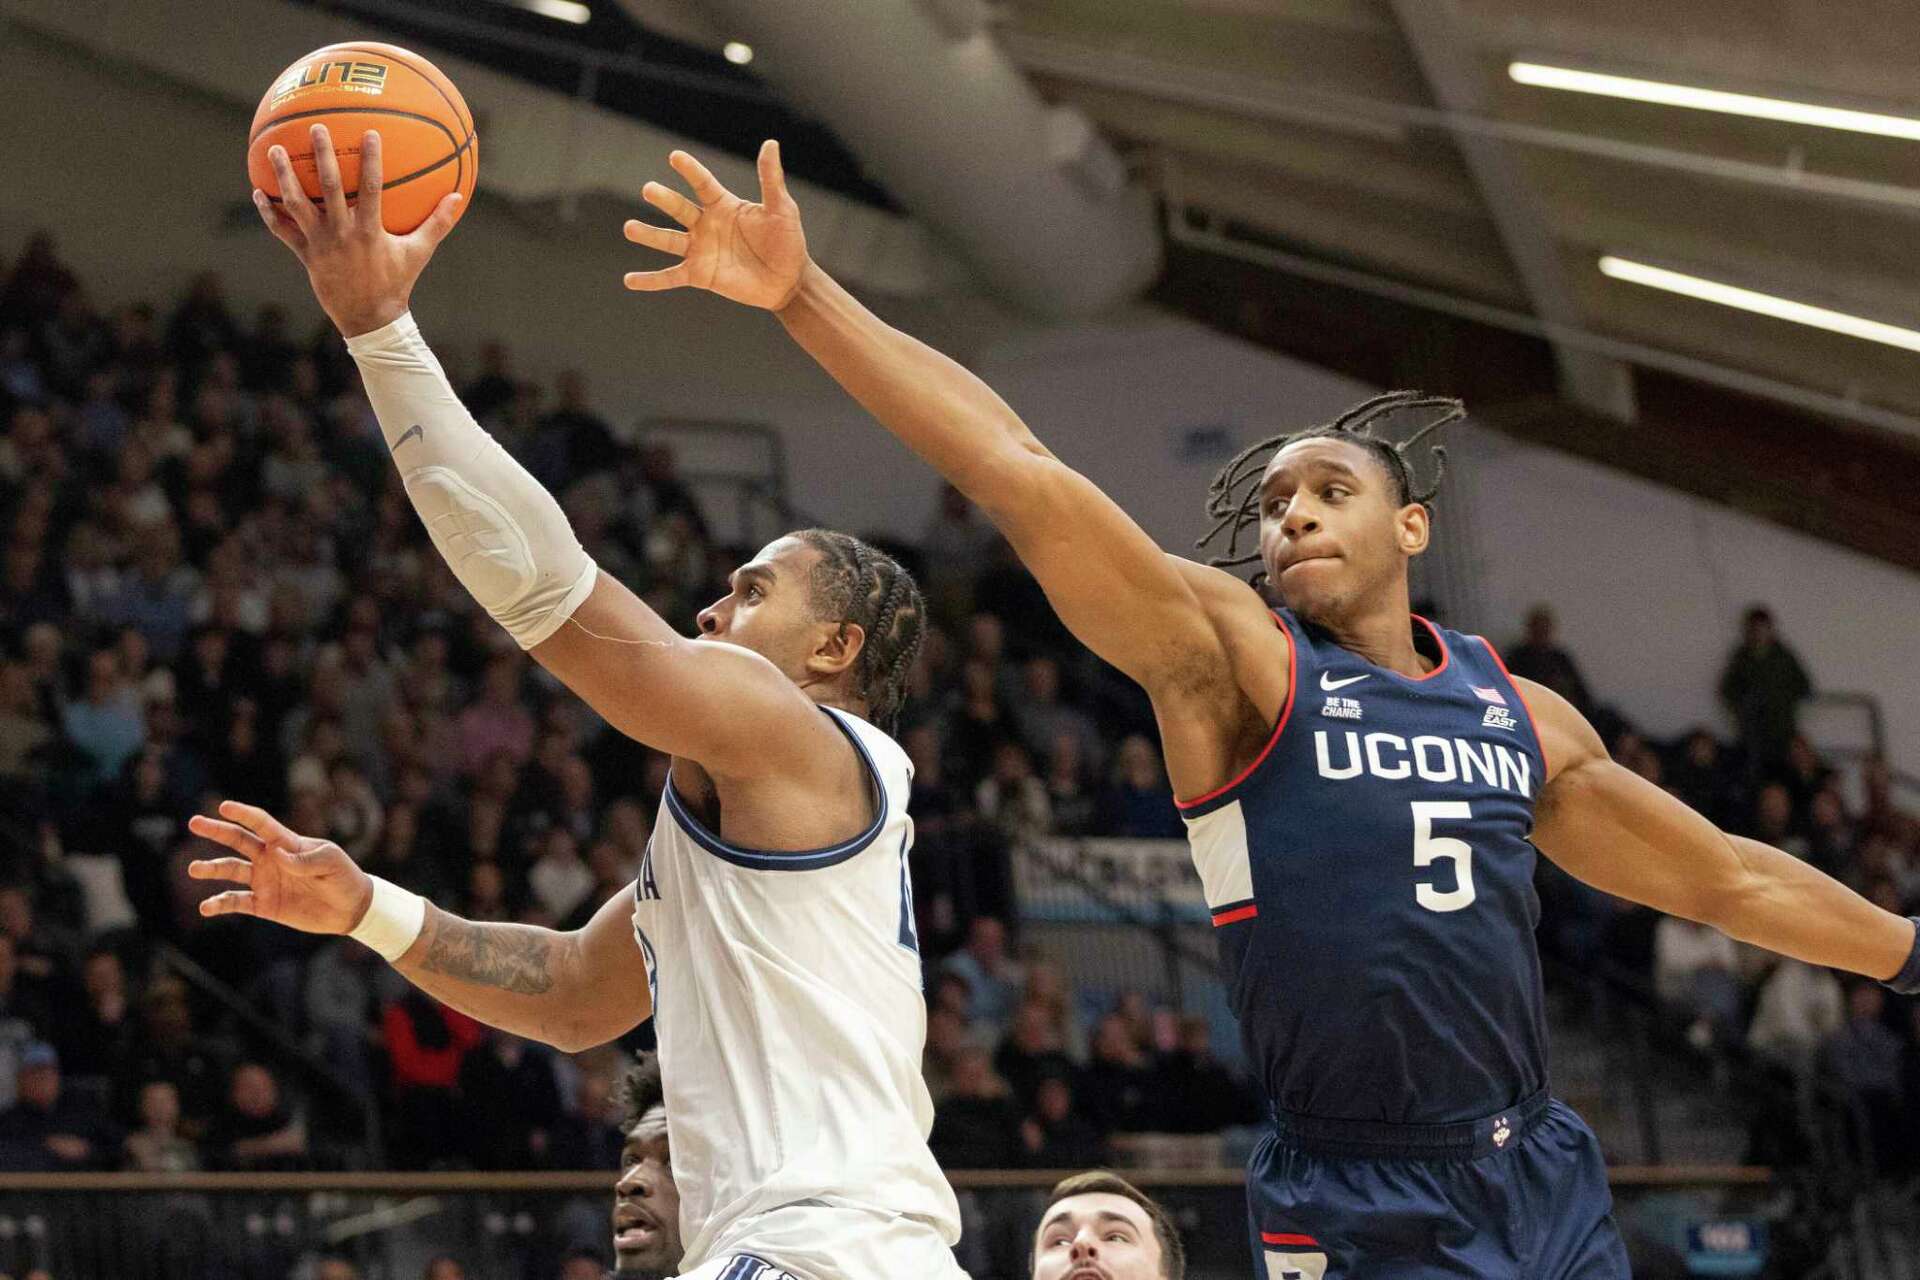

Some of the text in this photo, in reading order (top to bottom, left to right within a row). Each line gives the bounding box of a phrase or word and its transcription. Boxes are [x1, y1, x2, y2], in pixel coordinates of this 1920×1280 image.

[1326, 696, 1361, 709] BE THE
[1321, 705, 1363, 719] CHANGE
[1486, 705, 1510, 717] BIG
[1483, 714, 1517, 728] EAST
[1314, 731, 1531, 797] UCONN
[1411, 801, 1476, 912] 5
